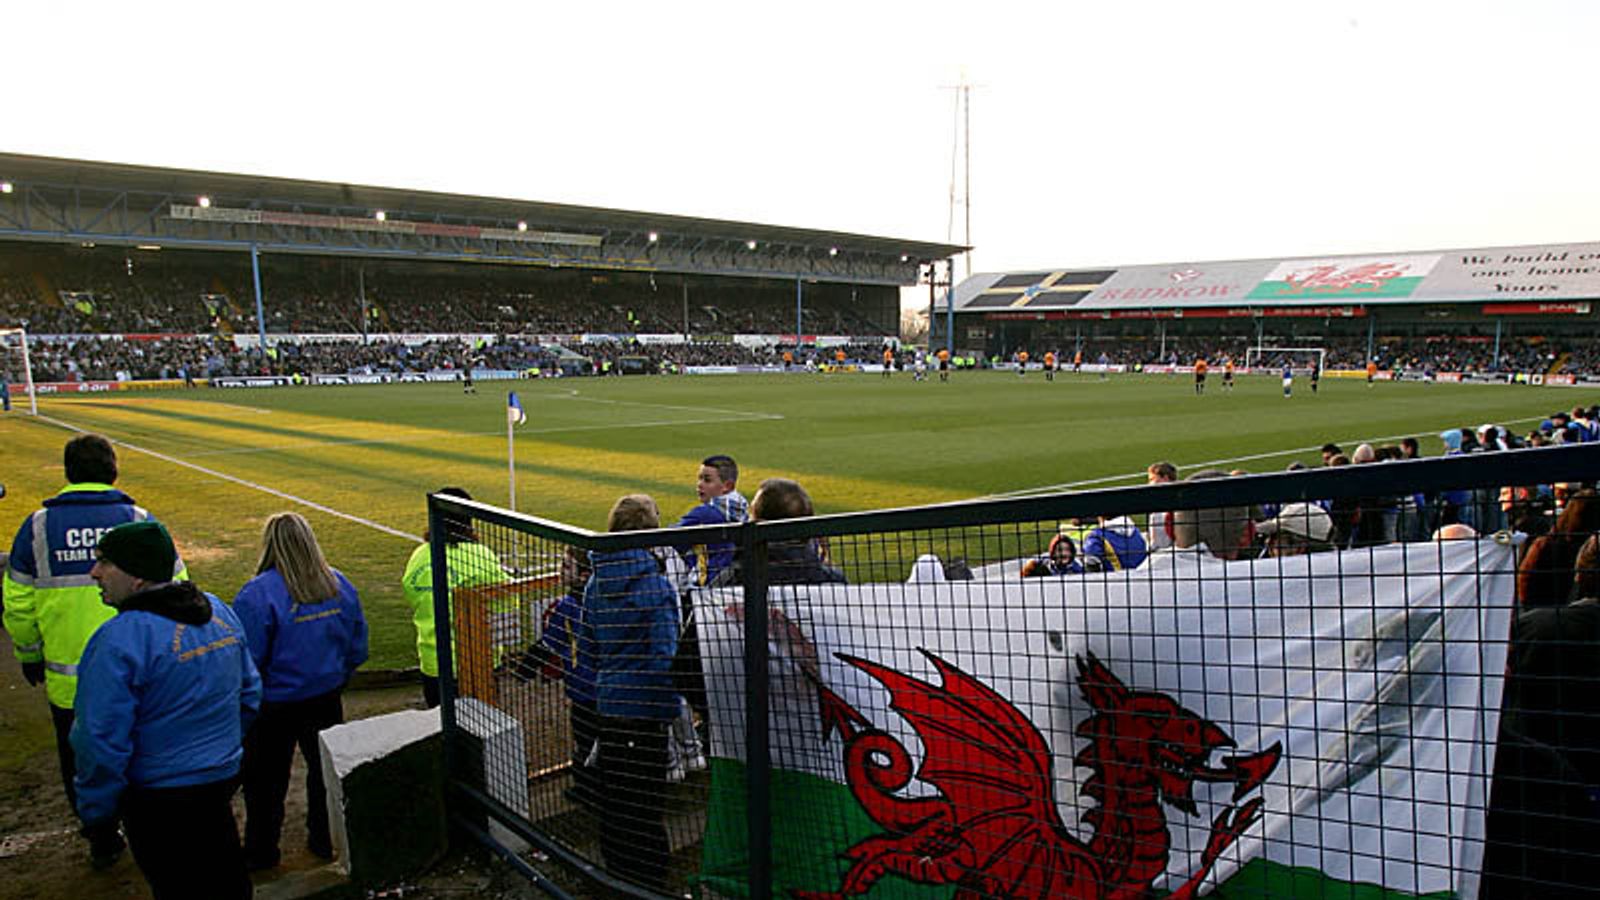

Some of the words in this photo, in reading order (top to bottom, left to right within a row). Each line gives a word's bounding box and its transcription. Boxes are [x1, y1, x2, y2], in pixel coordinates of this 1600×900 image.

[1461, 256, 1492, 264] We
[1503, 252, 1568, 263] build
[1101, 284, 1241, 300] REDROW
[1496, 284, 1559, 292] Yours
[55, 548, 88, 562] TEAM
